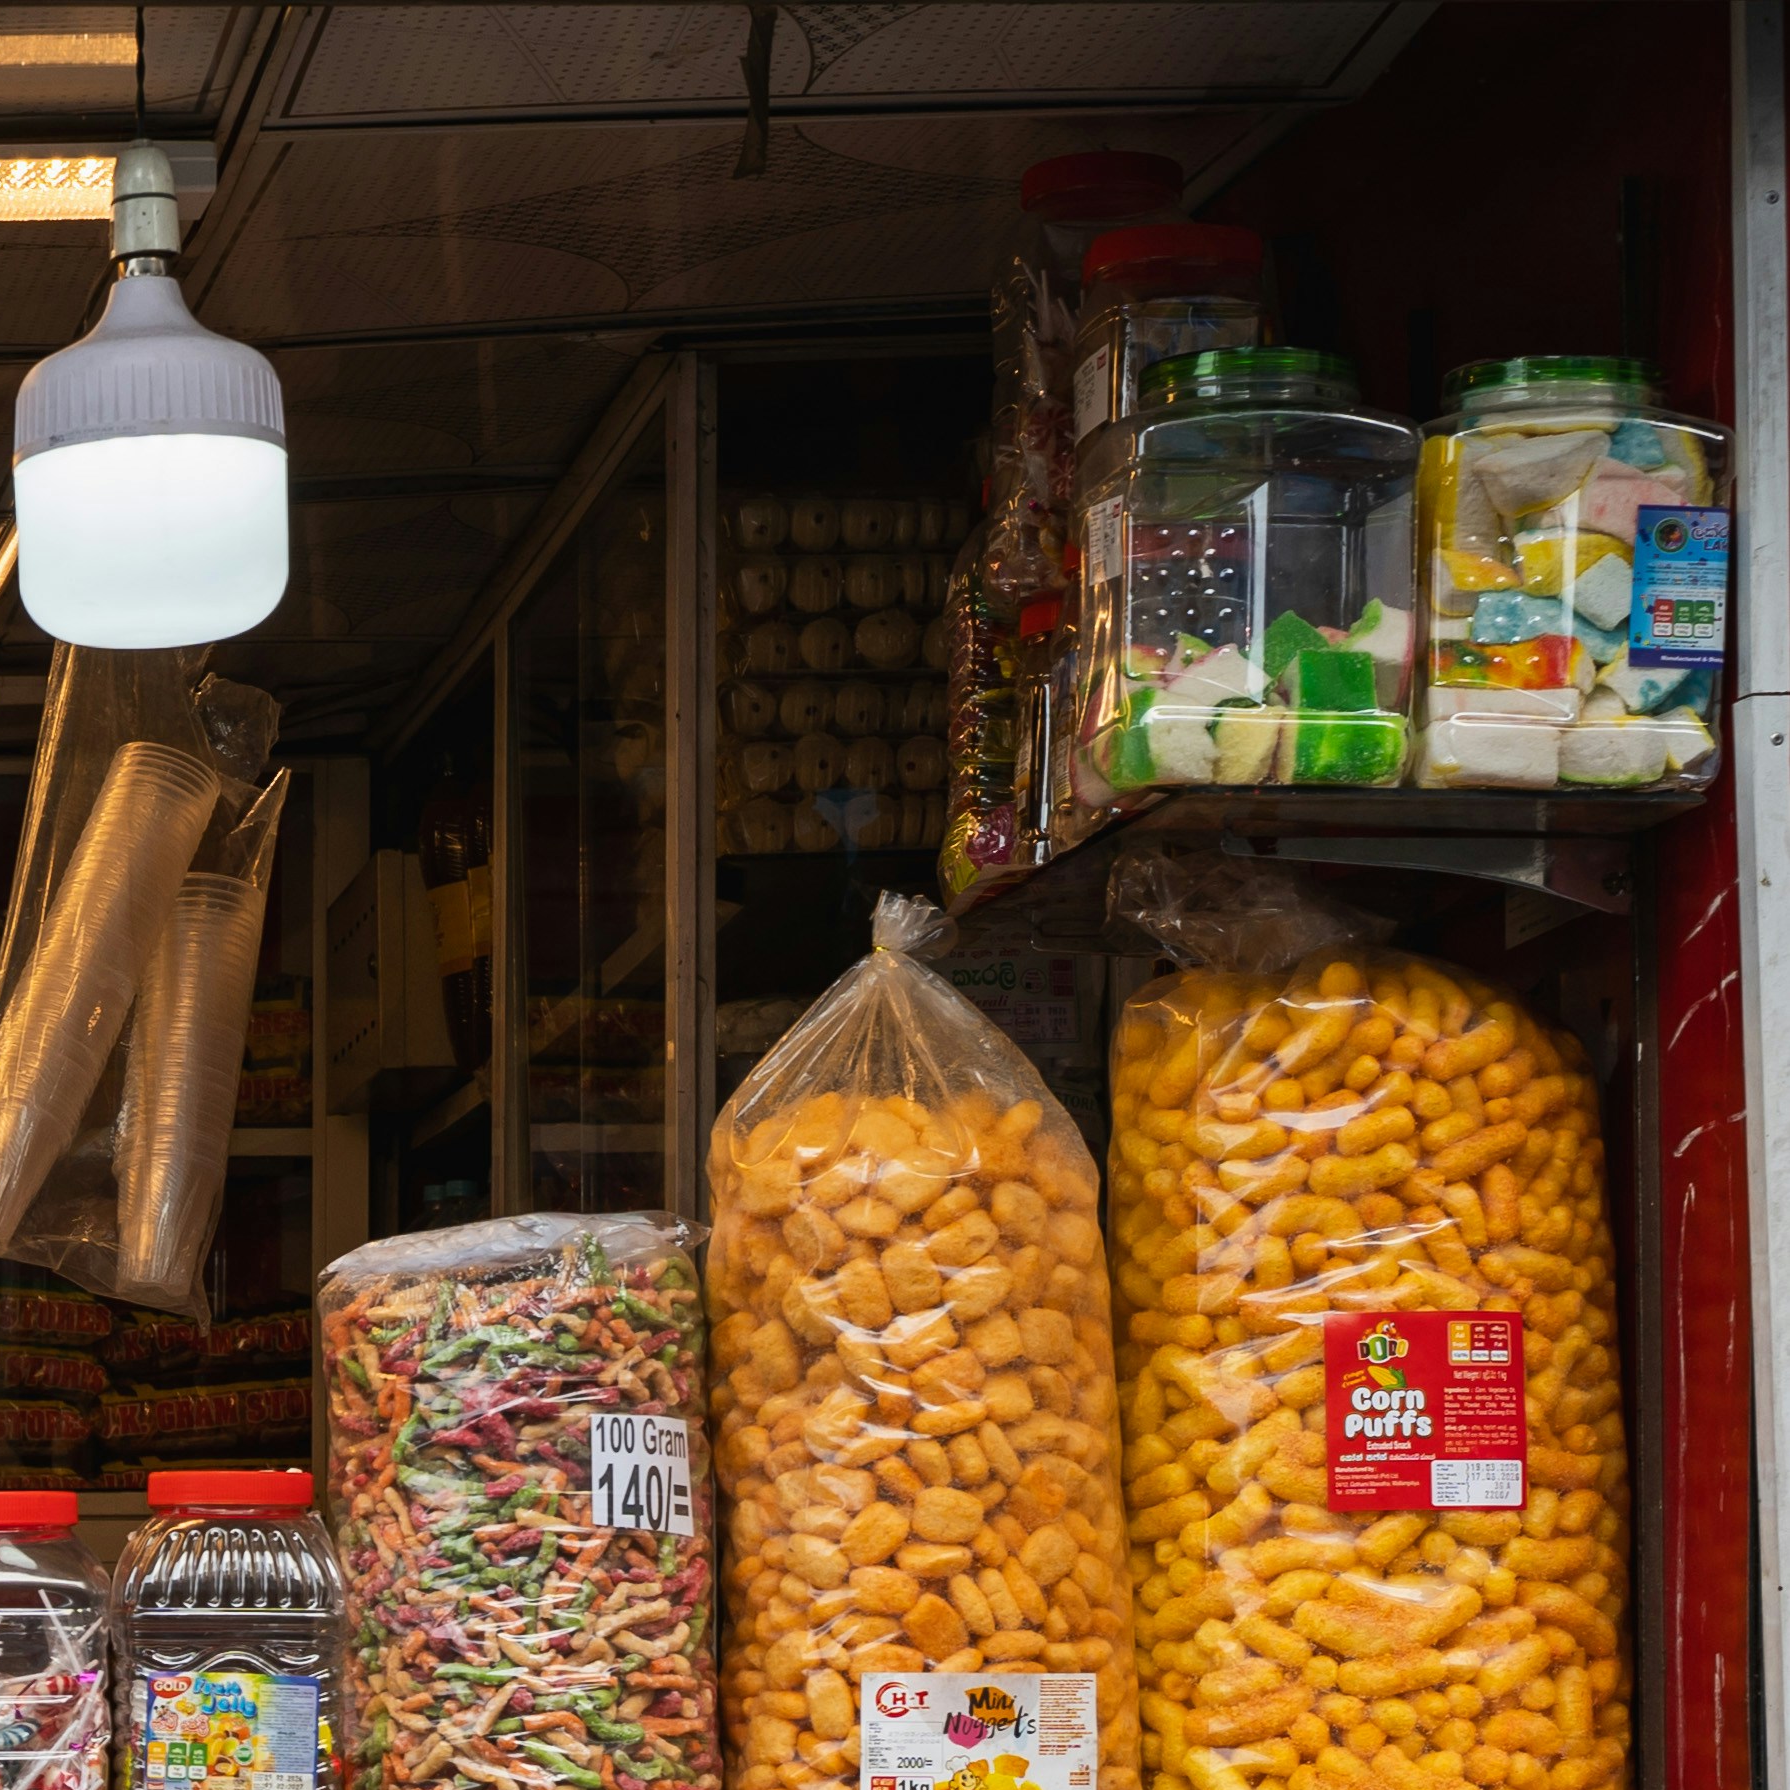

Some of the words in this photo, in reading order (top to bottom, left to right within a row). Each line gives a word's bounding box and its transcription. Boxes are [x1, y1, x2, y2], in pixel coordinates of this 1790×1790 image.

[1352, 1387, 1425, 1411] Corn
[596, 1417, 635, 1453] 100
[643, 1418, 686, 1458] Gram
[1344, 1411, 1433, 1438] Puffs
[598, 1463, 689, 1531] 140/=
[153, 1681, 188, 1692] GOLD
[968, 1687, 1018, 1716] Mini
[943, 1706, 1037, 1739] Nuggets
